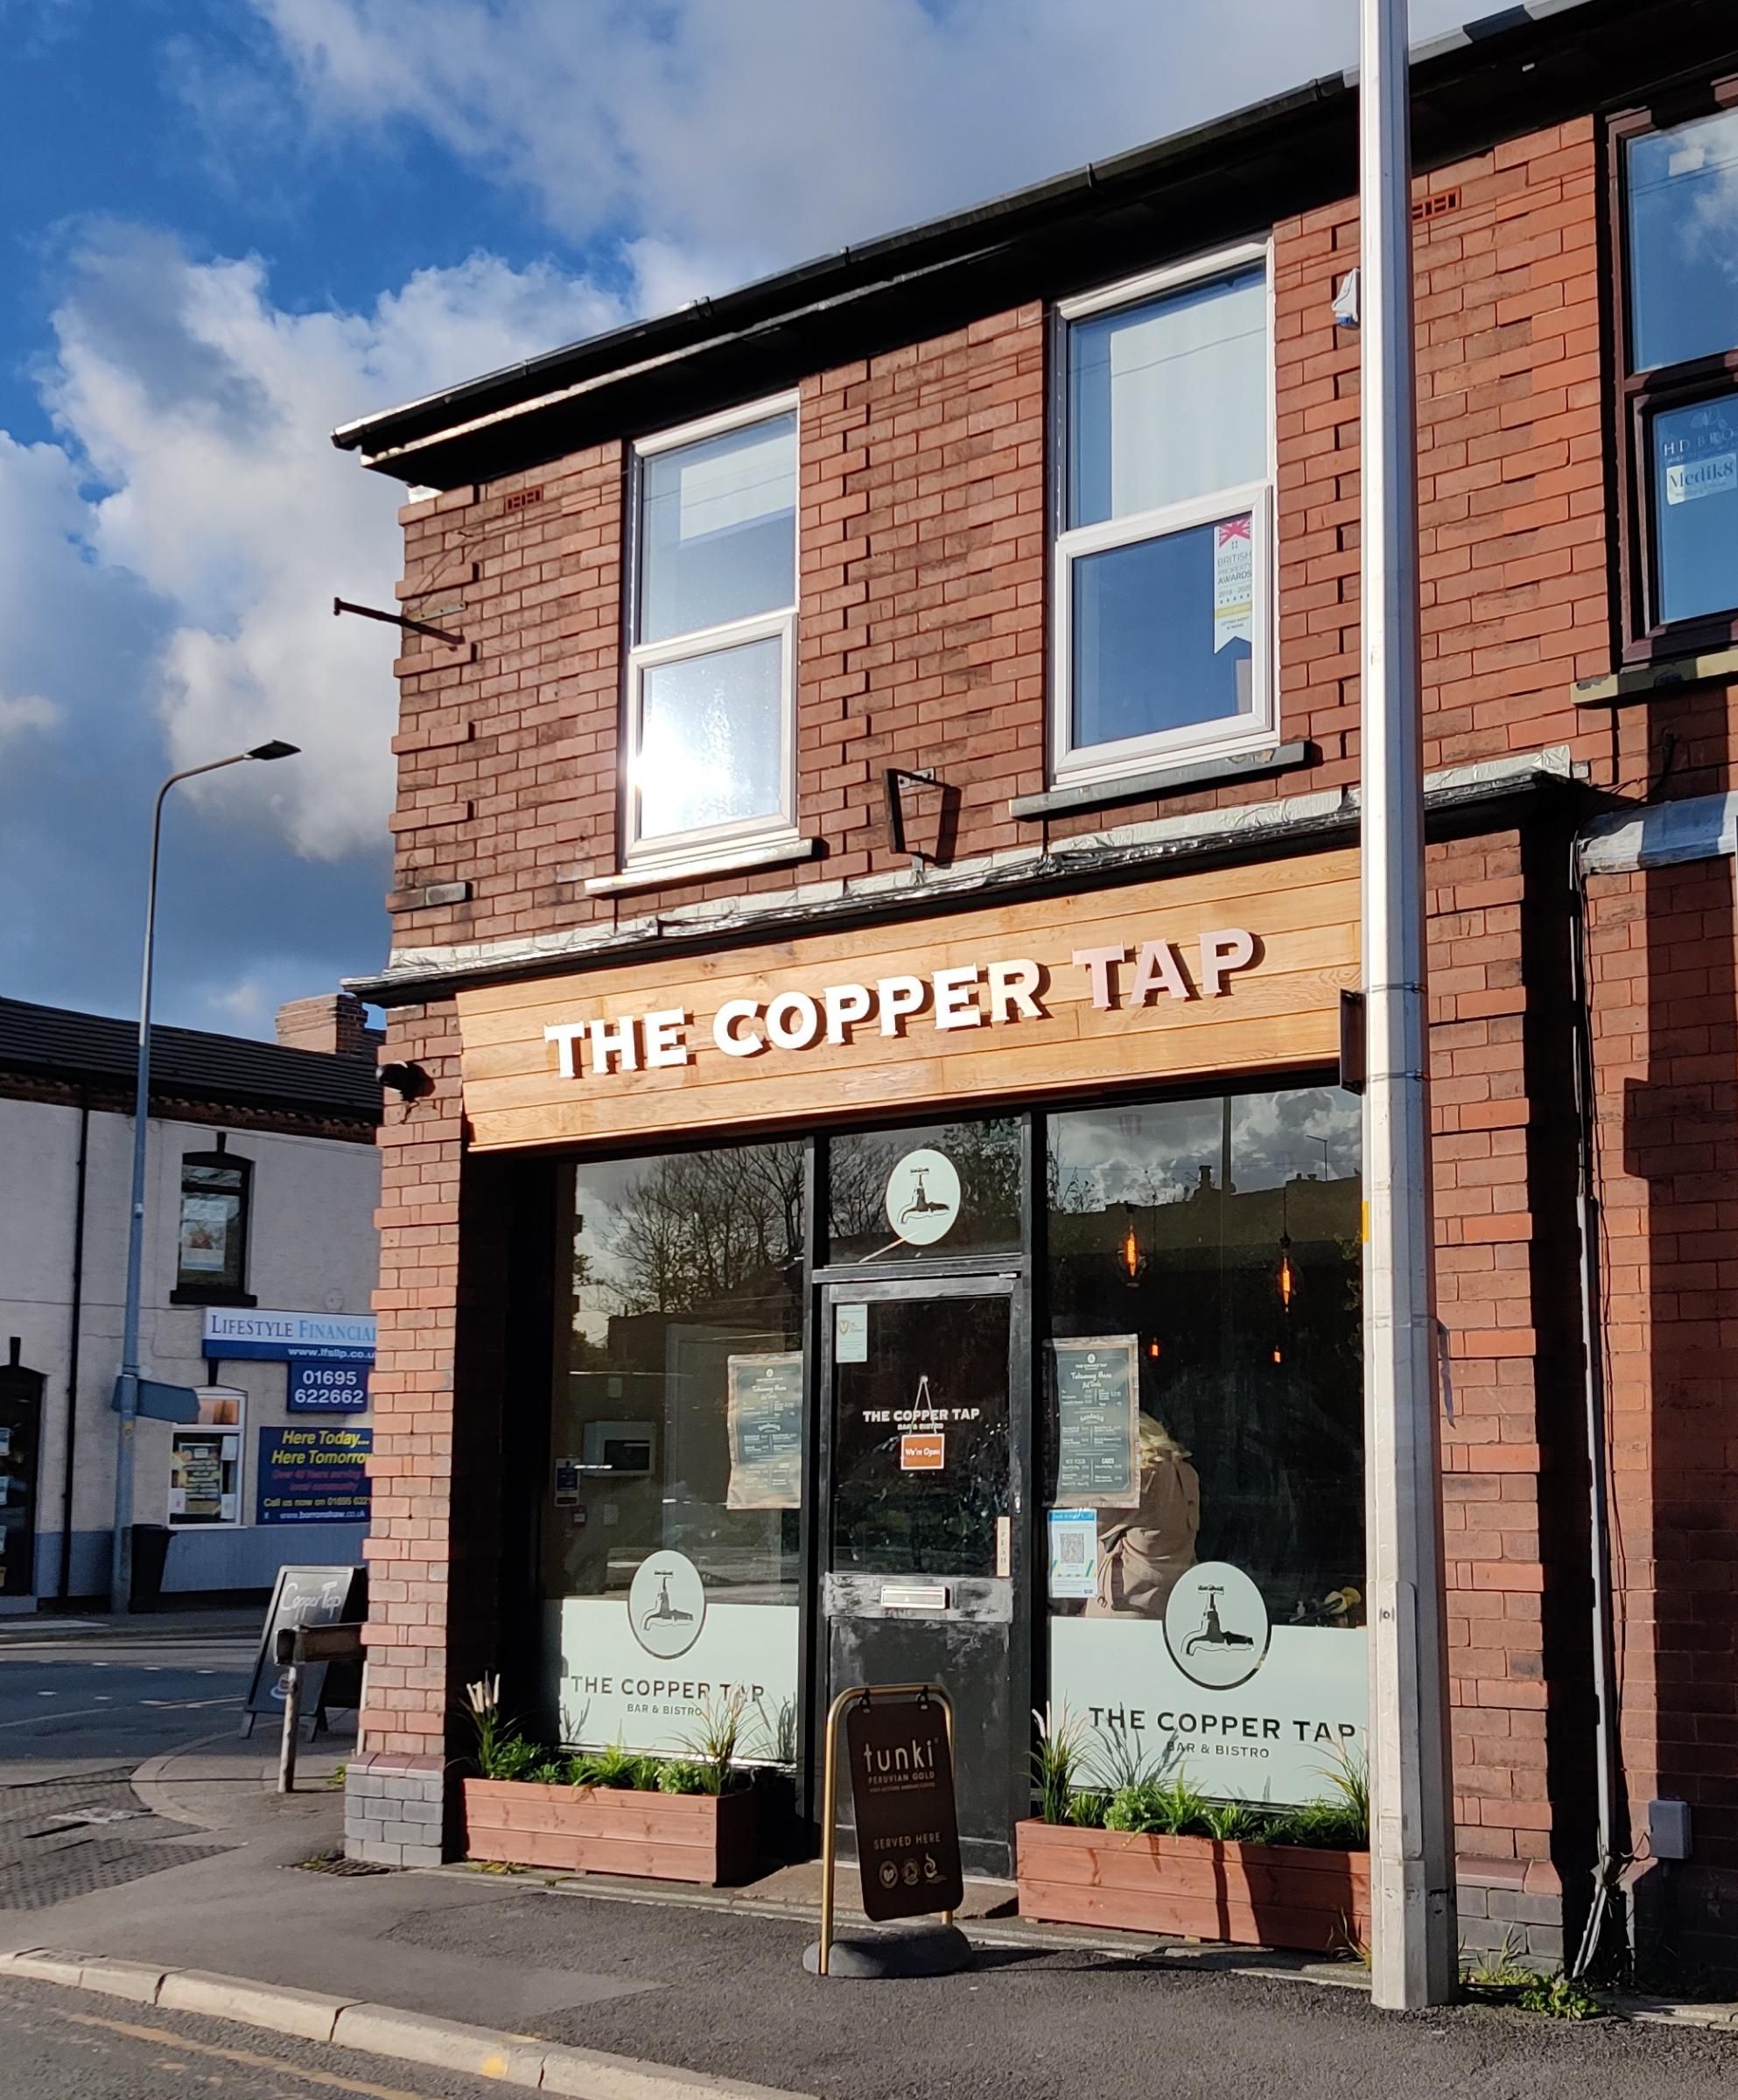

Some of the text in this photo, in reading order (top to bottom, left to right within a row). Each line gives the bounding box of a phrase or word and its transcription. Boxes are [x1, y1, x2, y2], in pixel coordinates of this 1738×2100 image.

[1698, 427, 1738, 448] BRO
[1670, 461, 1733, 487] Medik8
[1217, 550, 1252, 566] BRITISH
[1217, 570, 1252, 585] AWARDS
[543, 927, 1258, 1079] THE COPPER TAP
[211, 1314, 294, 1338] LIFESTYLE
[287, 1348, 375, 1360] www.lfsllp.co.u
[302, 1369, 357, 1385] 01695
[294, 1389, 364, 1404] 622662
[862, 1408, 980, 1422] THE COPPER TAP
[281, 1431, 316, 1445] Here
[271, 1450, 371, 1464] Here Tomorro
[923, 1447, 941, 1458] Open
[279, 1580, 341, 1620] Copper Tap
[571, 1676, 613, 1694] THE
[620, 1678, 711, 1699] COPPER
[627, 1703, 703, 1717] BAR & BISTRO
[1088, 1706, 1356, 1742] THE COPPER TAP
[863, 1739, 934, 1773] tunki
[1167, 1740, 1270, 1759] BAR & BISTRO
[867, 1770, 935, 1785] PERUVIAN GOLD
[873, 1831, 941, 1851] SERVED HERE
